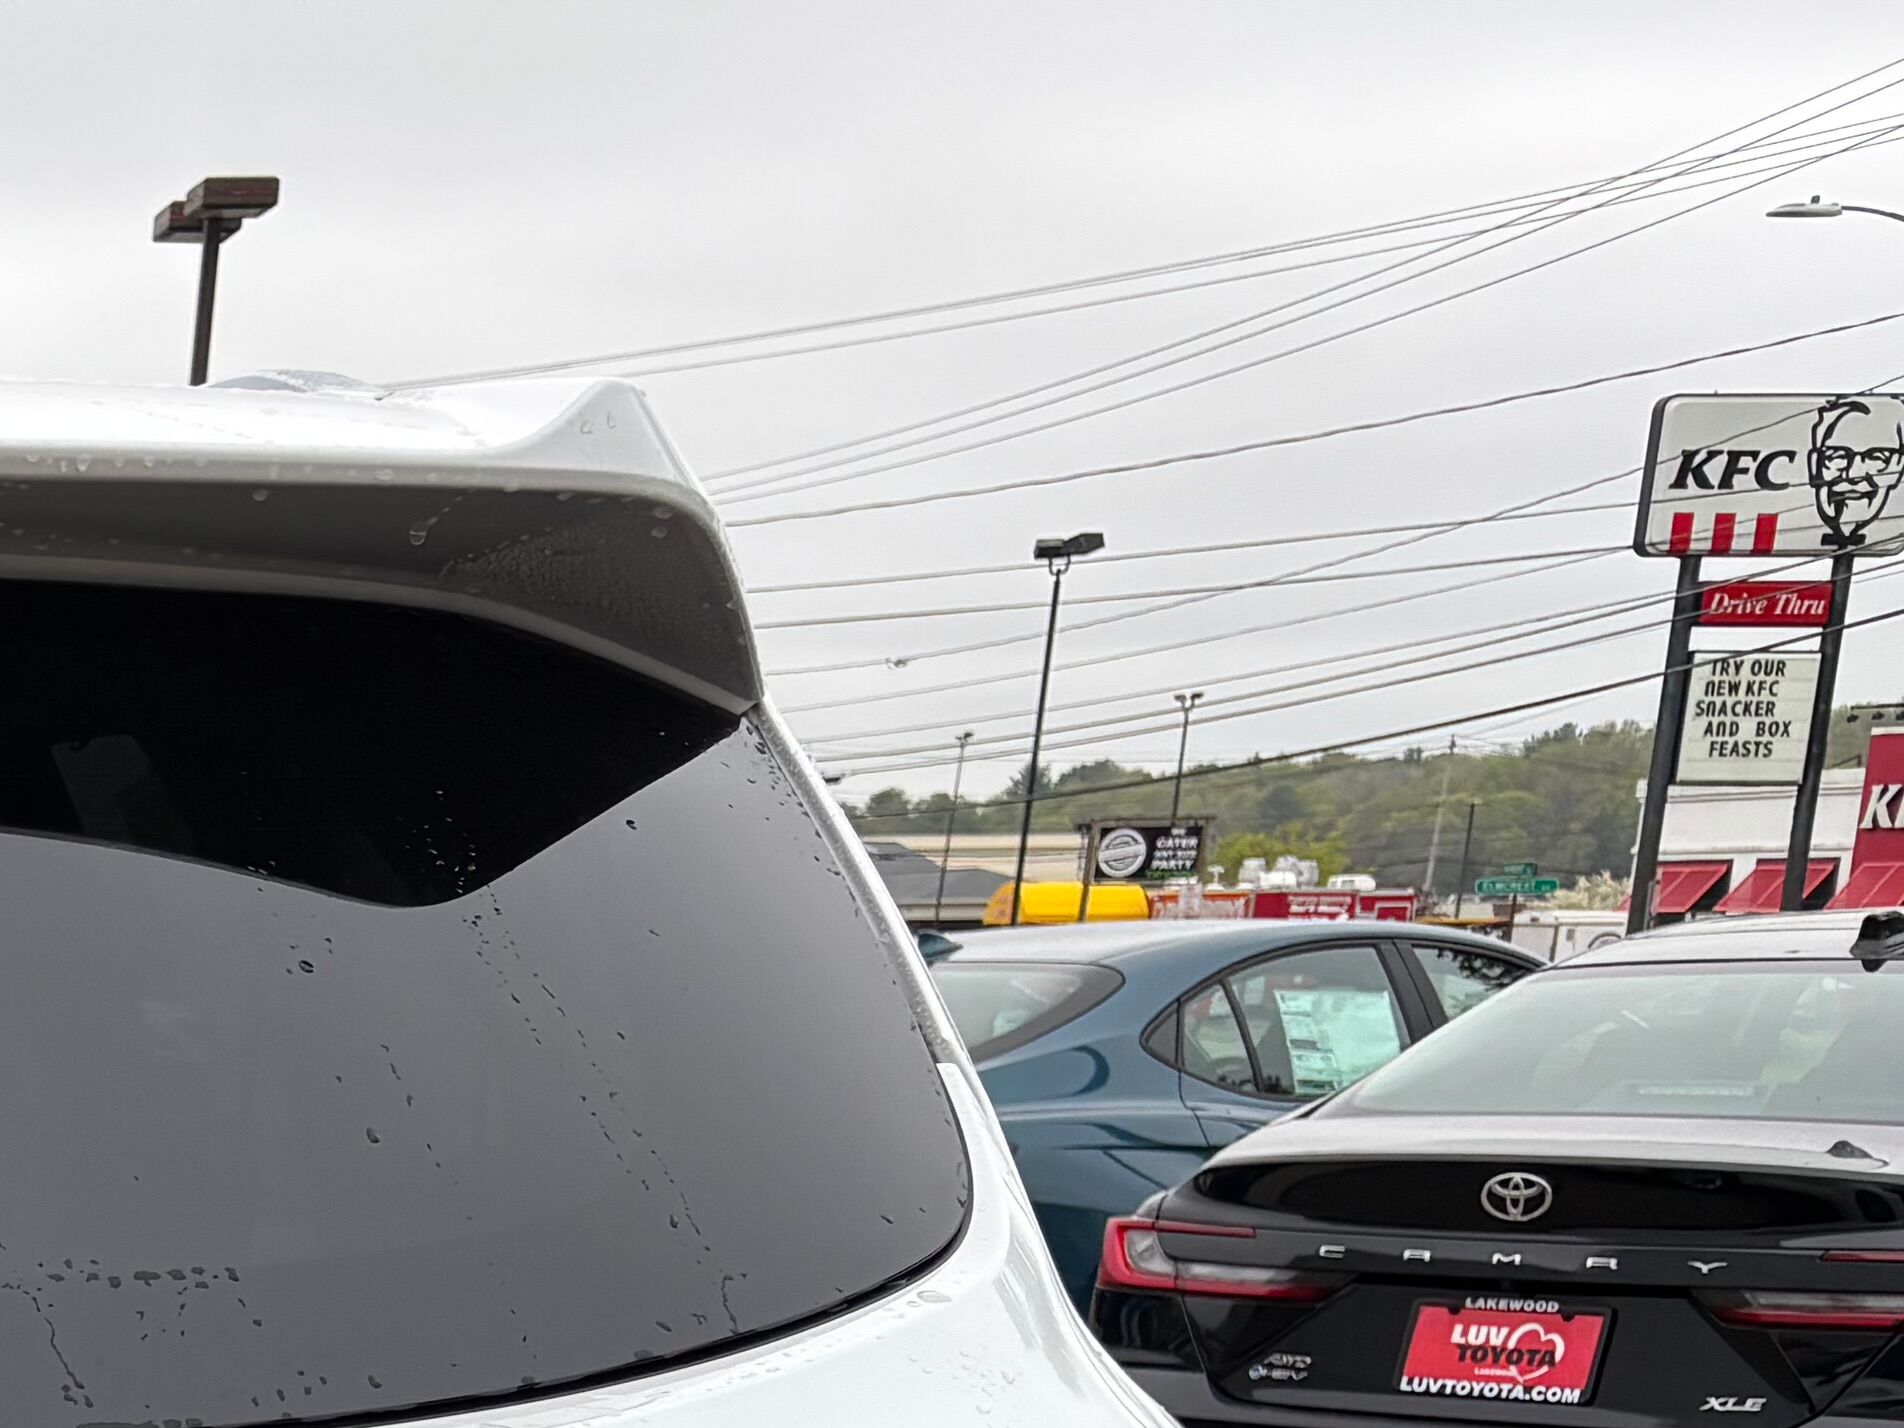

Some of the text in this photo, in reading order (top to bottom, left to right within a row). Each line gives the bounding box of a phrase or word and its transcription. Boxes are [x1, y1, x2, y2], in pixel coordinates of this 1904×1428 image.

[1668, 450, 1797, 490] KFC
[1709, 592, 1825, 615] Drive Thru
[1711, 659, 1786, 677] TRY OUR
[1704, 680, 1780, 697] NEW KFC
[1695, 700, 1776, 717] SNACKER
[1704, 720, 1792, 737] AND BOX
[1708, 741, 1773, 758] FEASTS
[1319, 1244, 1728, 1274] CAMRY
[1465, 1297, 1559, 1313] LAKEWOOD
[1451, 1323, 1511, 1345] LUV
[1456, 1344, 1556, 1368] TOYOTA
[1399, 1375, 1581, 1404] LUVTOYOTA.COM
[1699, 1396, 1767, 1412] XLE
